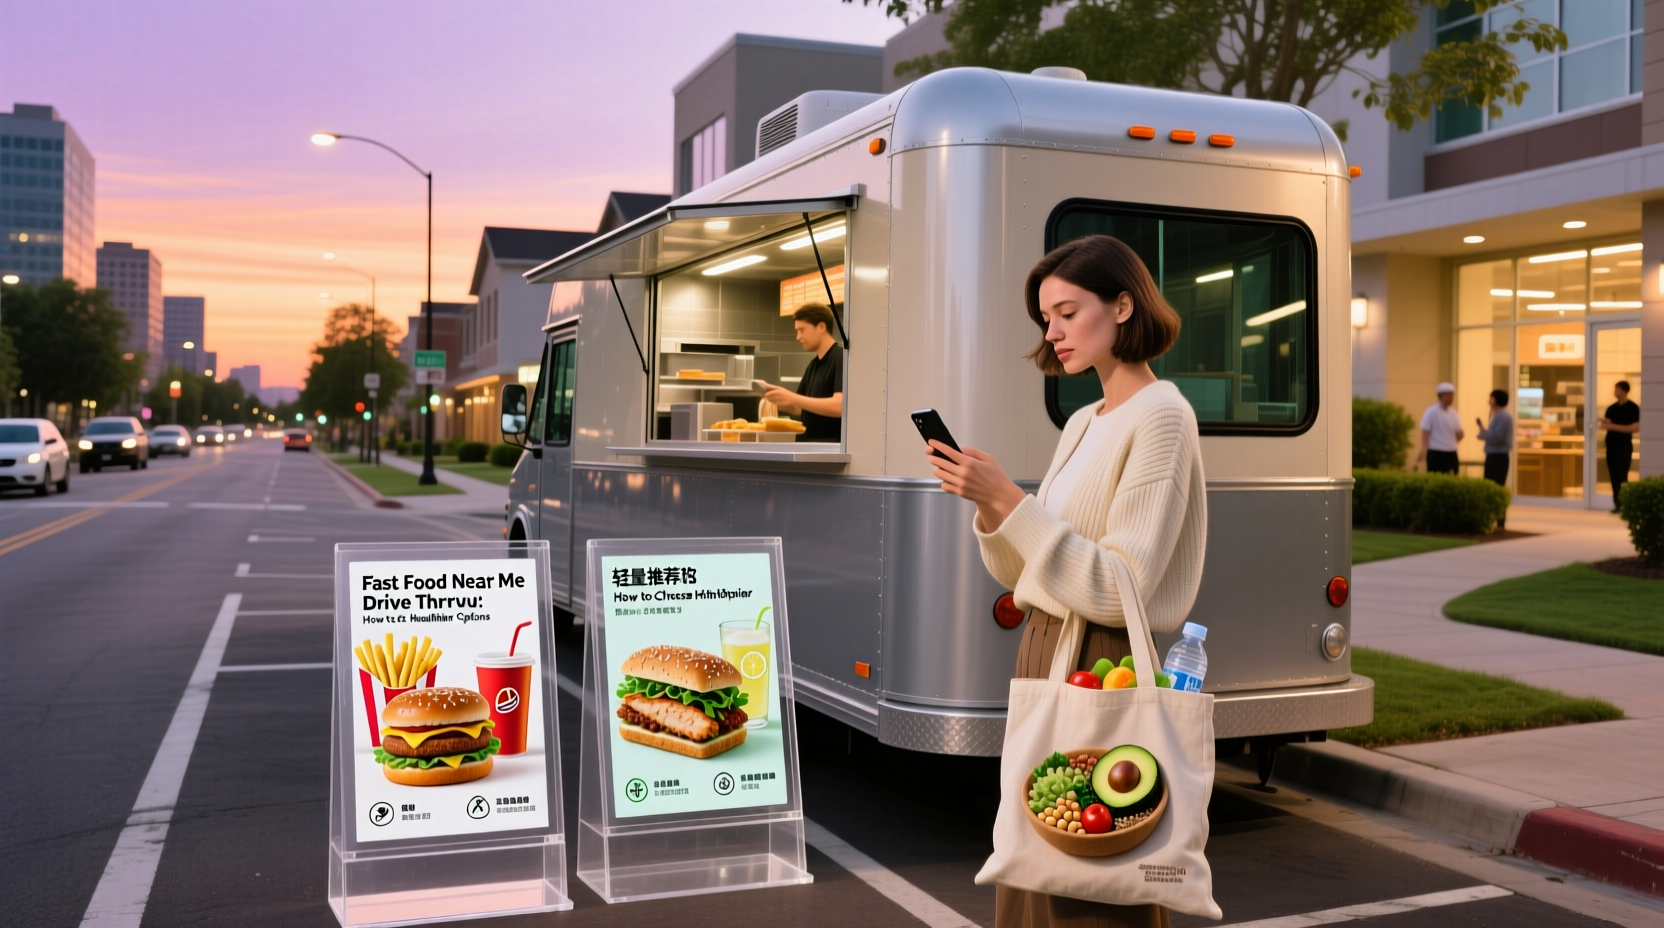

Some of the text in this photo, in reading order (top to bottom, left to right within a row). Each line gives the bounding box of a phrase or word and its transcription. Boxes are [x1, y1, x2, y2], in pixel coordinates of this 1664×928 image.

[362, 572, 525, 590] Fast Food Near Me
[363, 594, 411, 610] Drive
[614, 592, 638, 602] How
[641, 591, 652, 601] to
[363, 615, 384, 624] How
